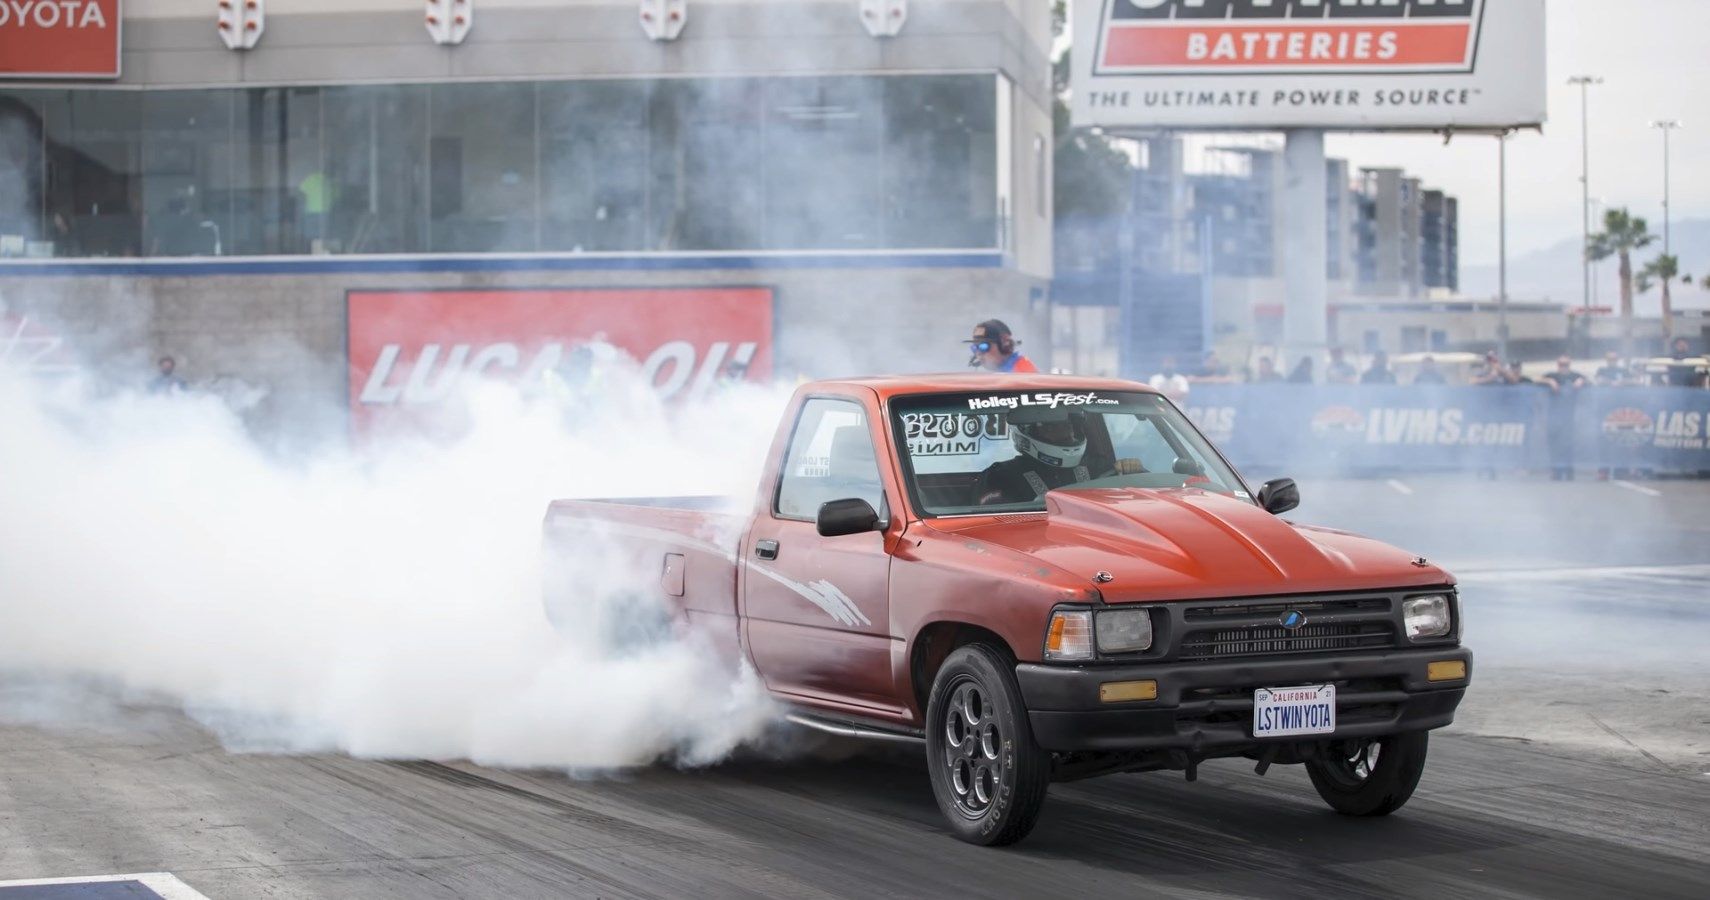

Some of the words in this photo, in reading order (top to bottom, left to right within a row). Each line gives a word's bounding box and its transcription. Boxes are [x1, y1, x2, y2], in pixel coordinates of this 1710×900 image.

[1186, 31, 1398, 60] BATTERIES
[1088, 91, 1130, 107] THE
[1144, 90, 1259, 107] ULTIMATE
[1273, 90, 1361, 106] POWER
[968, 396, 1019, 410] Holley
[1366, 408, 1526, 445] LVMS.com
[1656, 410, 1701, 436] LAS
[1258, 693, 1268, 701] SEP
[1273, 691, 1318, 702] CALIFORNIA
[1258, 703, 1331, 731] LSTWINYOTA
